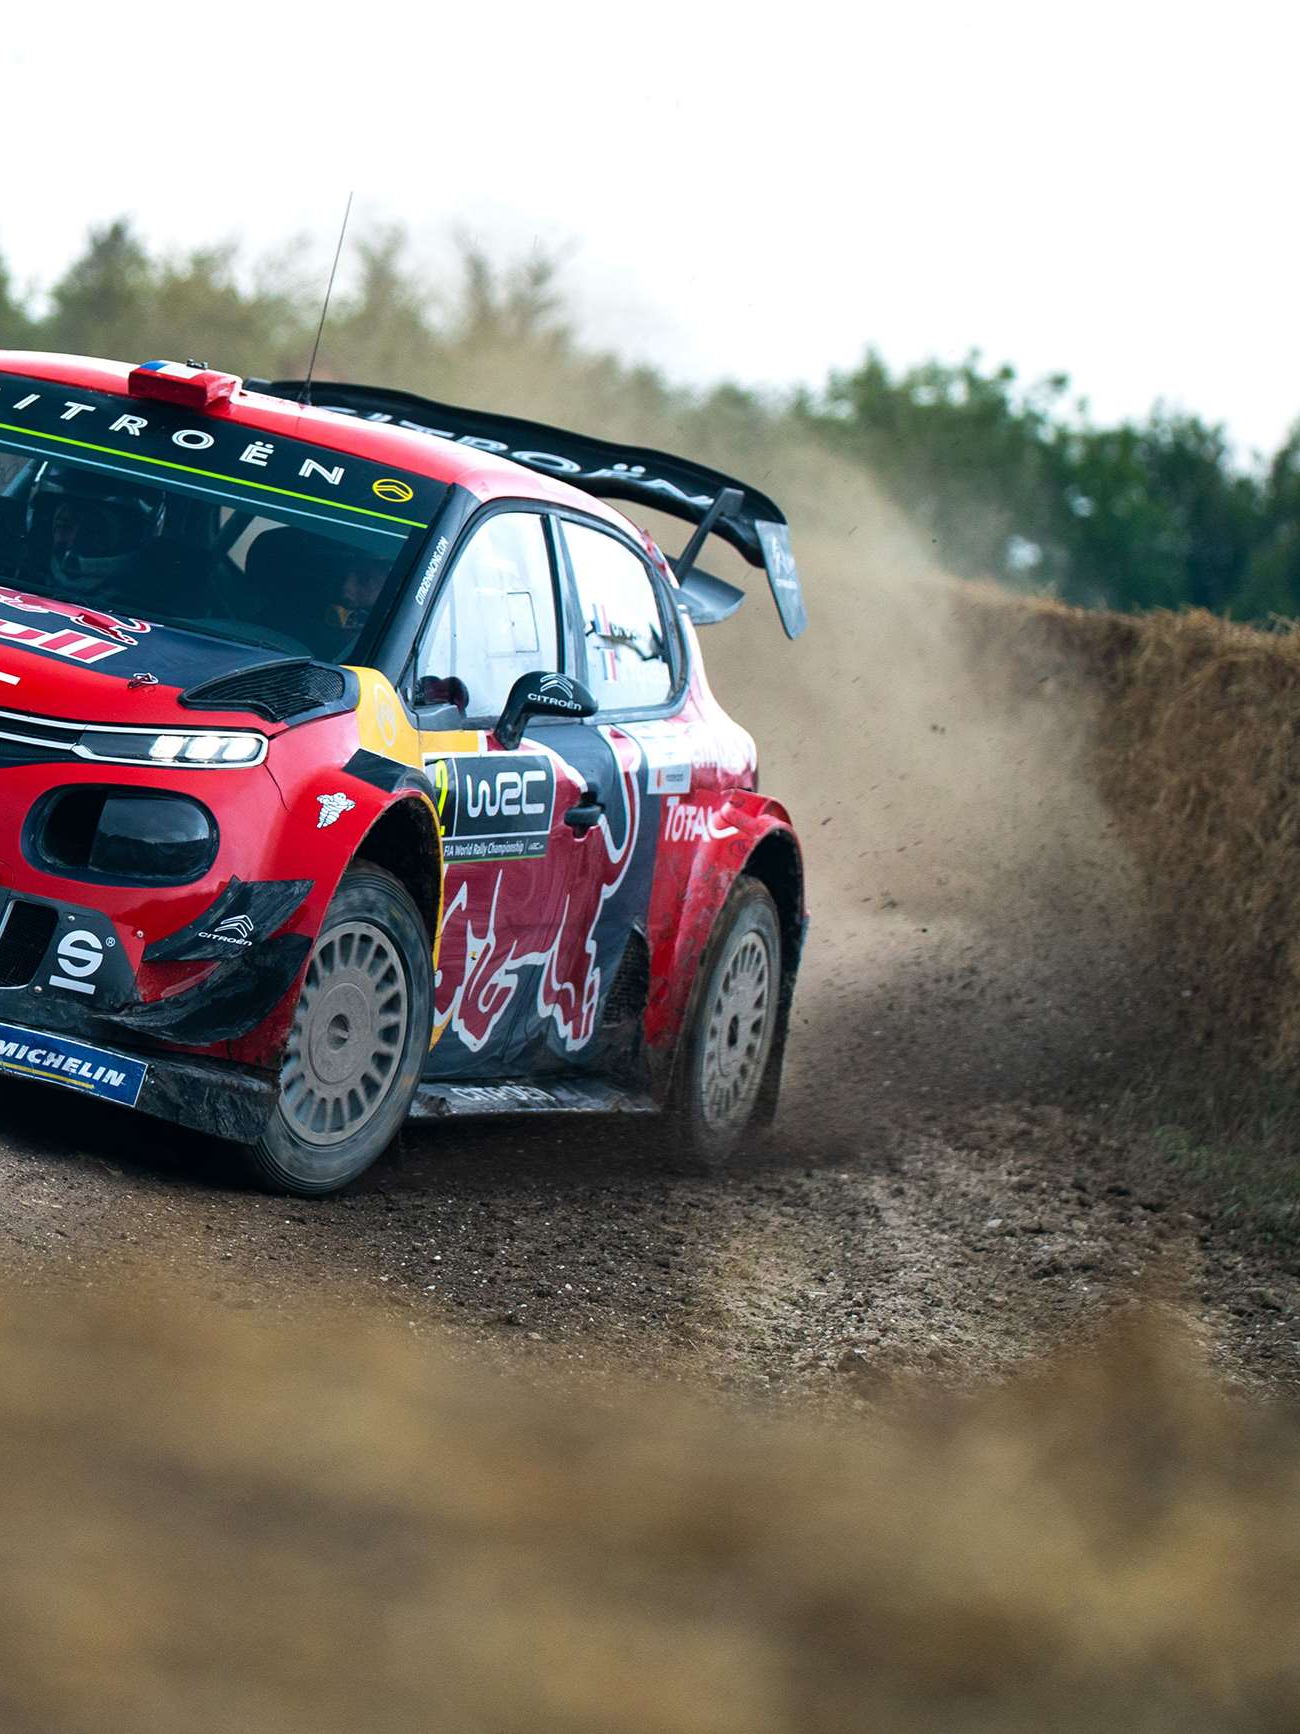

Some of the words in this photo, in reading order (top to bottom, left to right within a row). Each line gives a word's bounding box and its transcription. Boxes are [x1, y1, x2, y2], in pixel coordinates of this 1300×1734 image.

[527, 692, 582, 711] CITROËN
[466, 770, 547, 818] WRC
[664, 795, 739, 842] TOTAL
[444, 844, 455, 857] FIA
[455, 842, 473, 856] World
[474, 840, 488, 857] Rally
[488, 839, 525, 856] Championship
